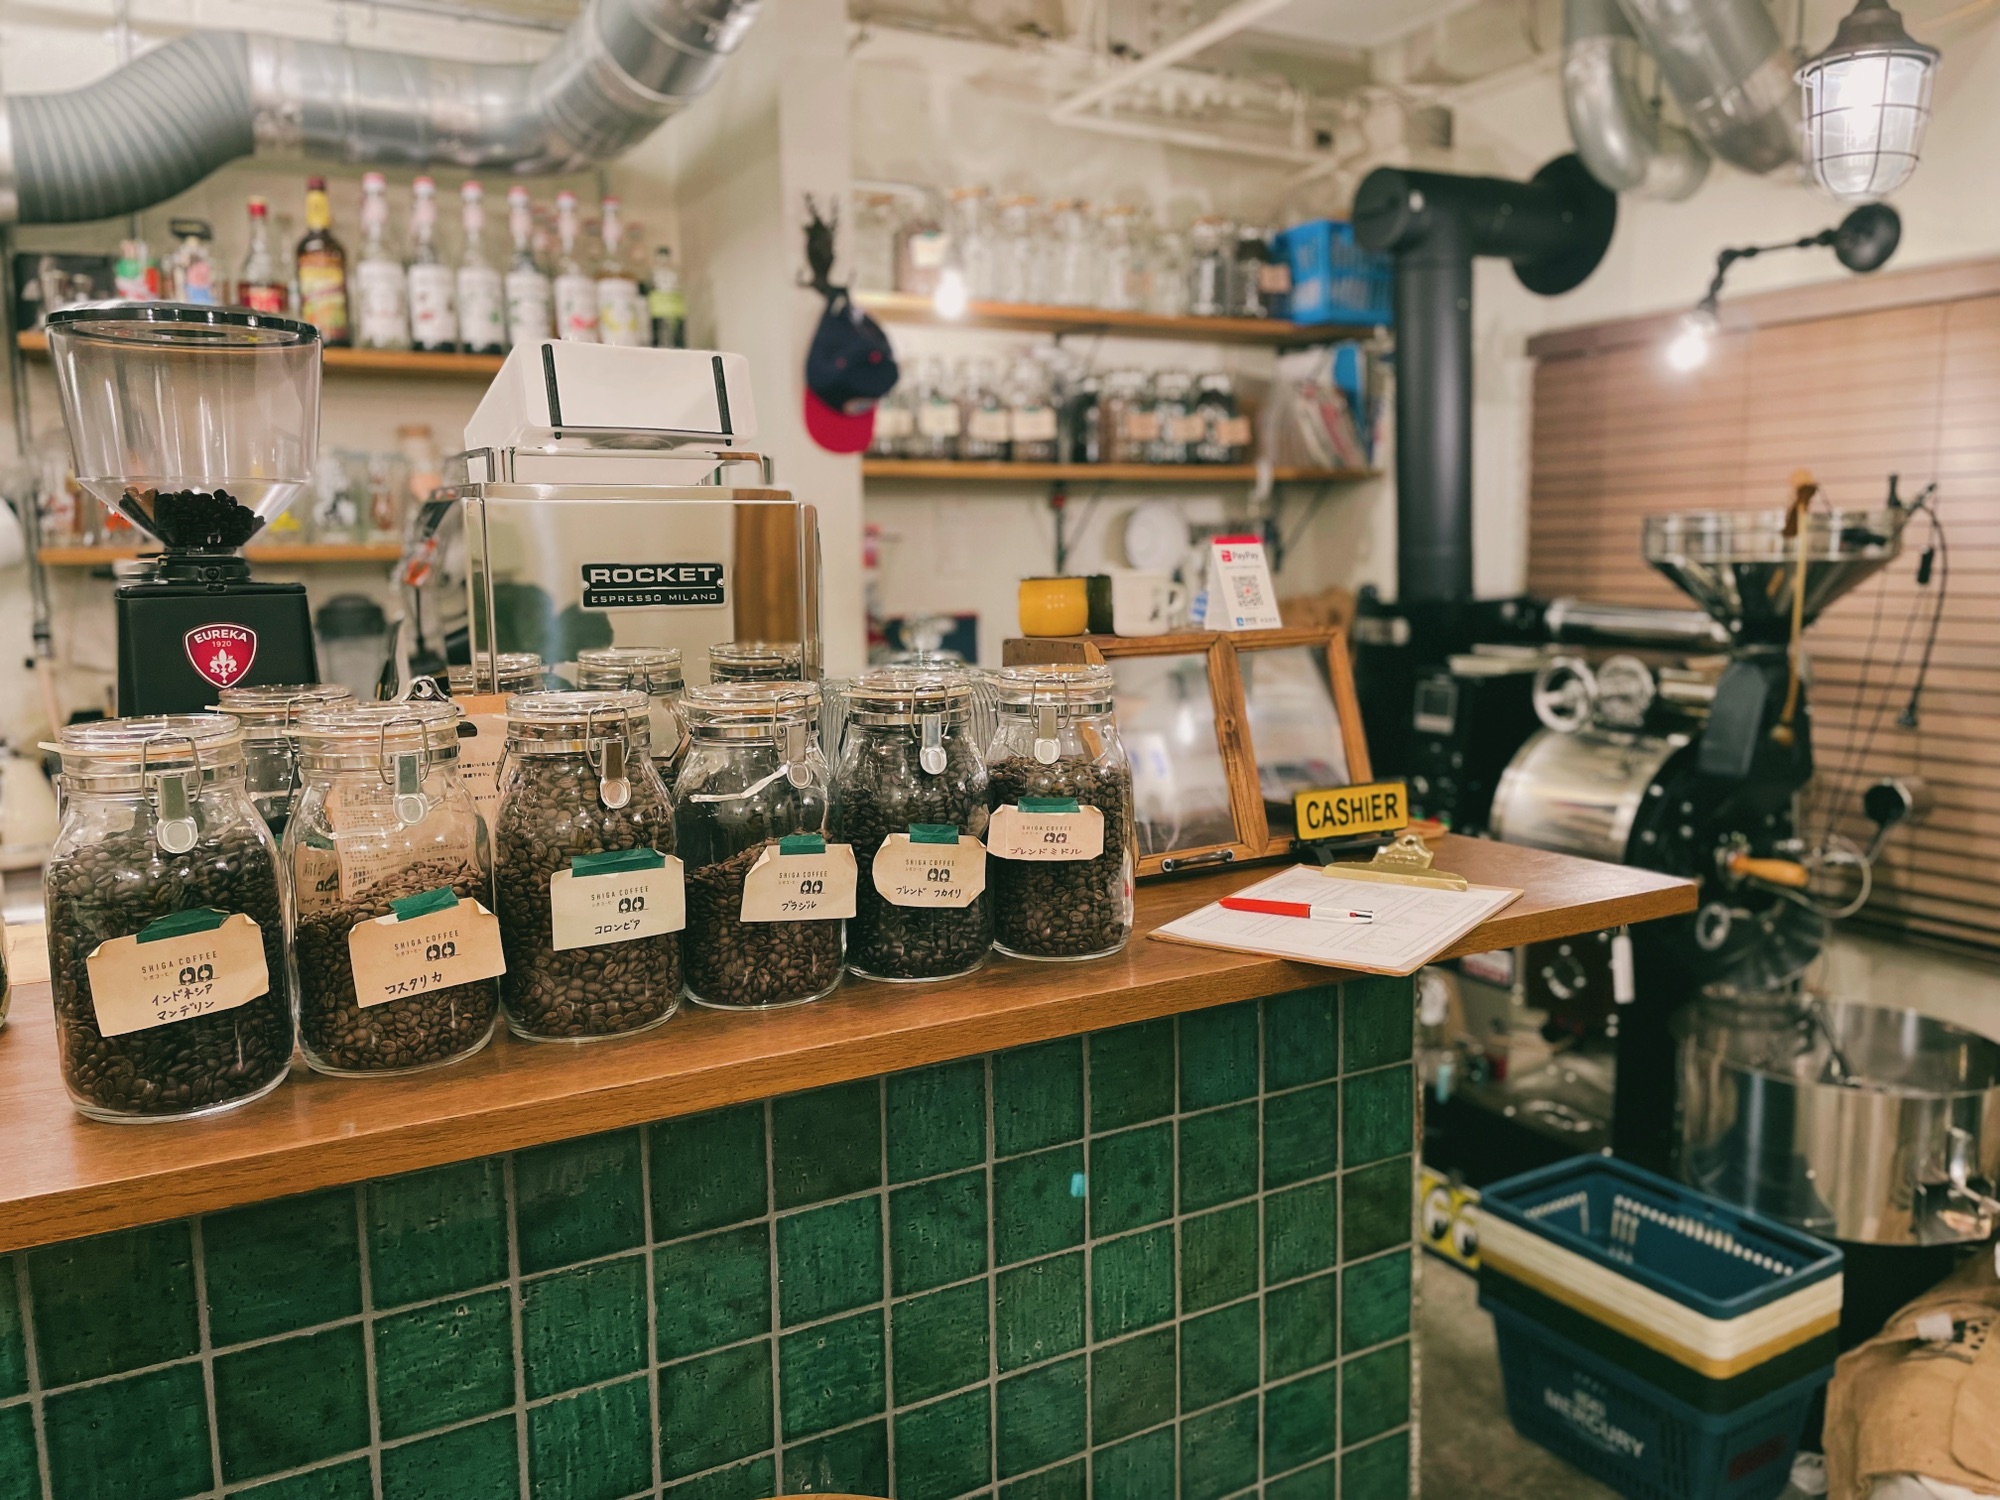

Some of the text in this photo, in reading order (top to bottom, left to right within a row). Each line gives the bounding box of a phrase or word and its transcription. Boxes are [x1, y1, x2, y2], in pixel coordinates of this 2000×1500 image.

[1232, 551, 1259, 561] PayPay
[589, 567, 716, 584] ROCKET
[591, 593, 717, 603] ESPRESSO MILANO
[193, 629, 247, 644] EUREKA
[212, 640, 232, 648] 1920
[1306, 793, 1399, 829] CASHIER
[929, 859, 955, 867] COFFEE
[779, 871, 800, 879] SHIGA
[591, 885, 649, 901] SHIGA COFFEE
[896, 885, 962, 899] ブレンド フカイリ
[781, 900, 817, 911] ブラジル
[594, 918, 641, 935] コロンビア
[394, 929, 459, 951] SHIGA COFFEE
[141, 950, 218, 974] SHIGA COFFEE
[385, 971, 442, 994] コスタリカ
[151, 983, 213, 1006] インドネシア
[157, 1001, 215, 1020] マンデリン
